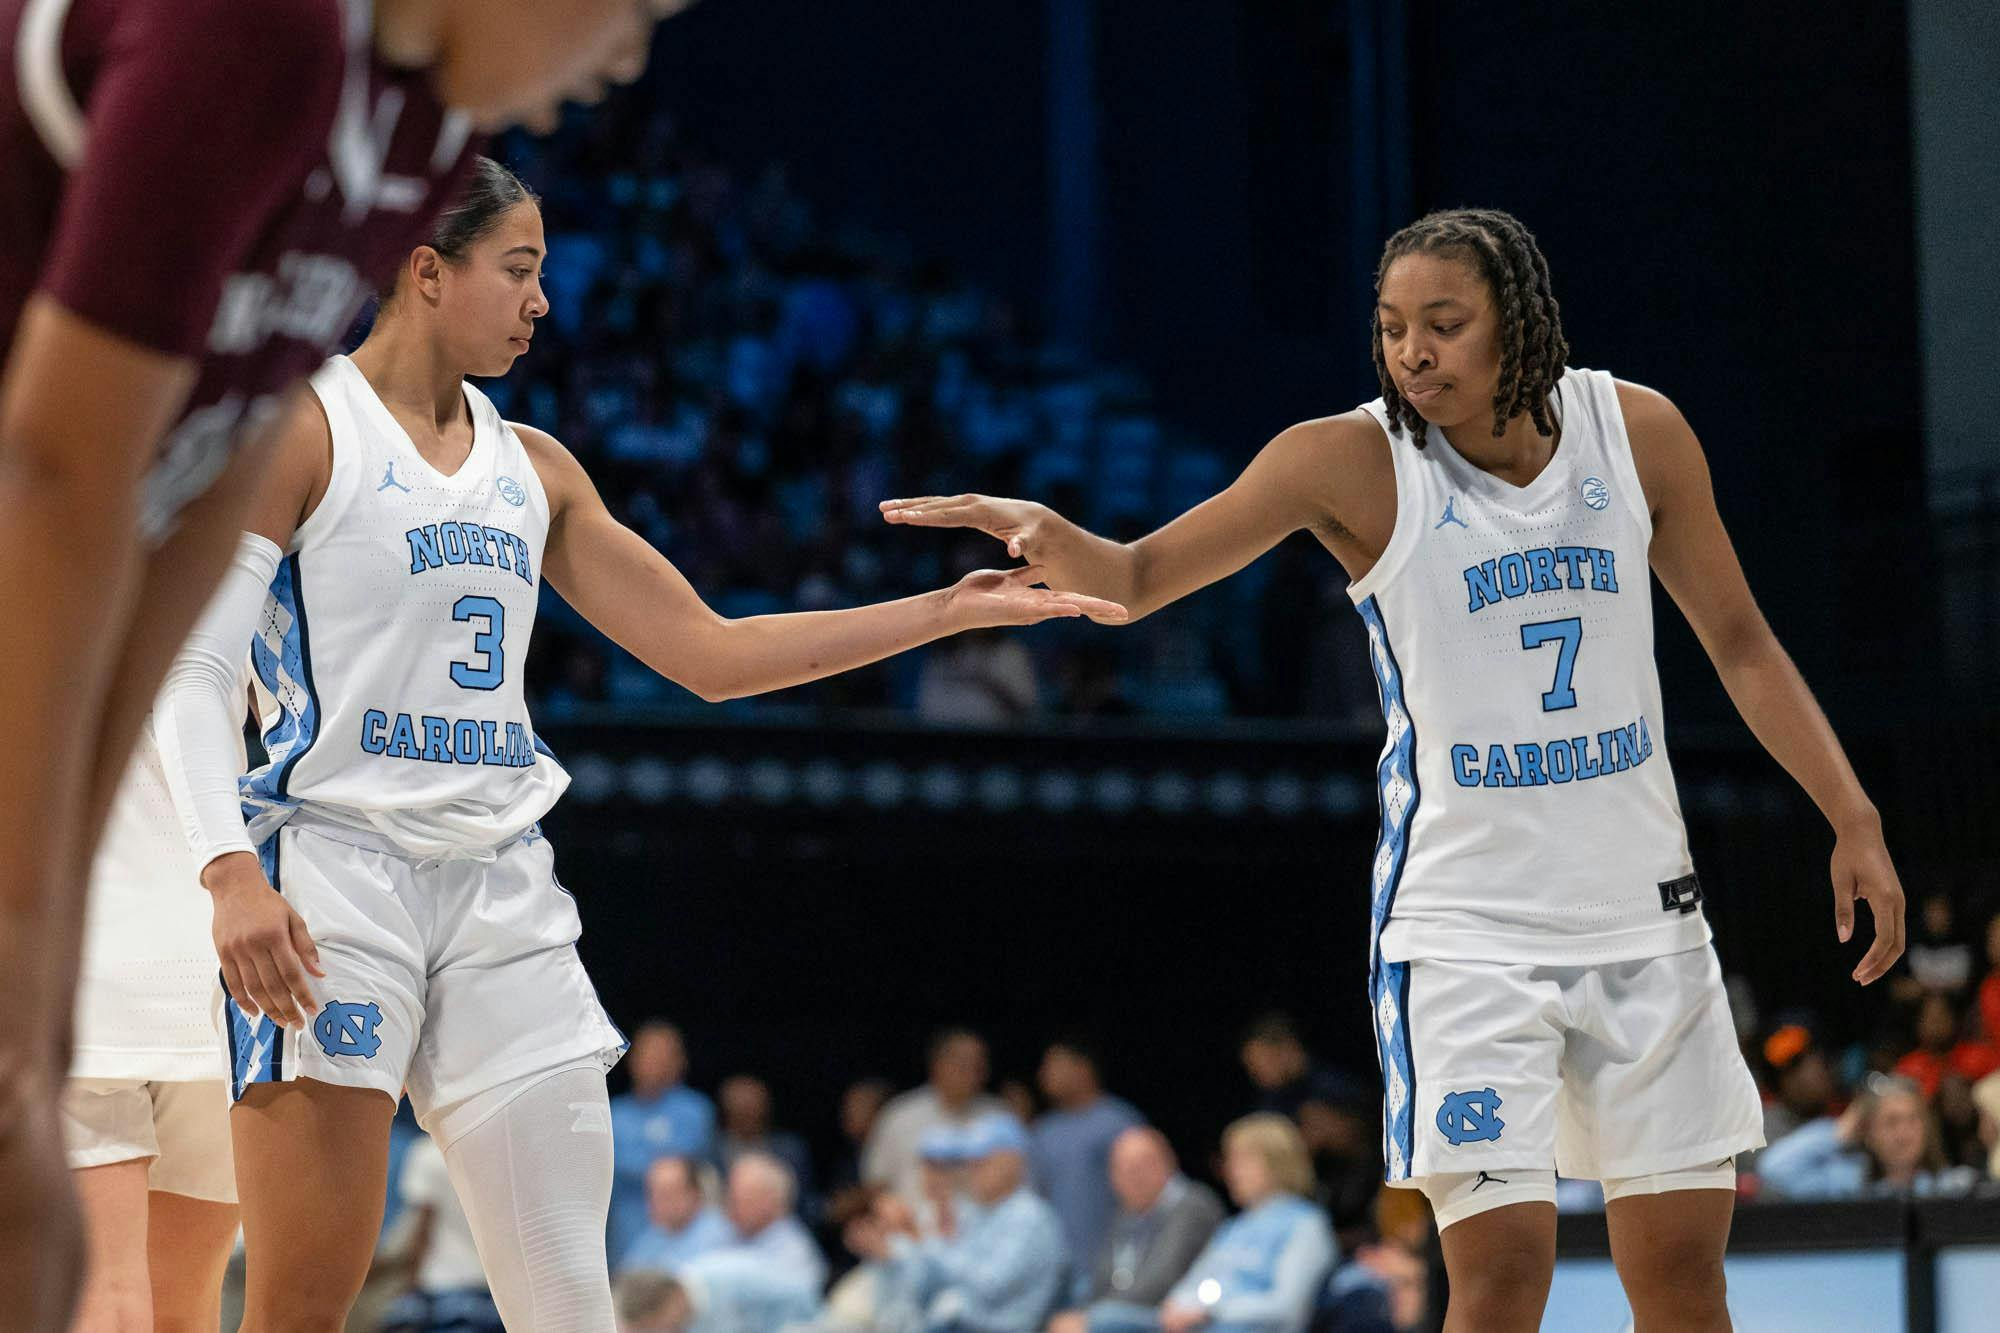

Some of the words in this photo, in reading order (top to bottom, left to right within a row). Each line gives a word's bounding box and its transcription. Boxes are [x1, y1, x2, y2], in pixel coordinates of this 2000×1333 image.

[406, 521, 533, 586] NORTH
[1463, 546, 1619, 613] NORTH
[449, 595, 504, 691] 3
[1520, 617, 1583, 712] 7
[1450, 715, 1653, 787] CAROLINA
